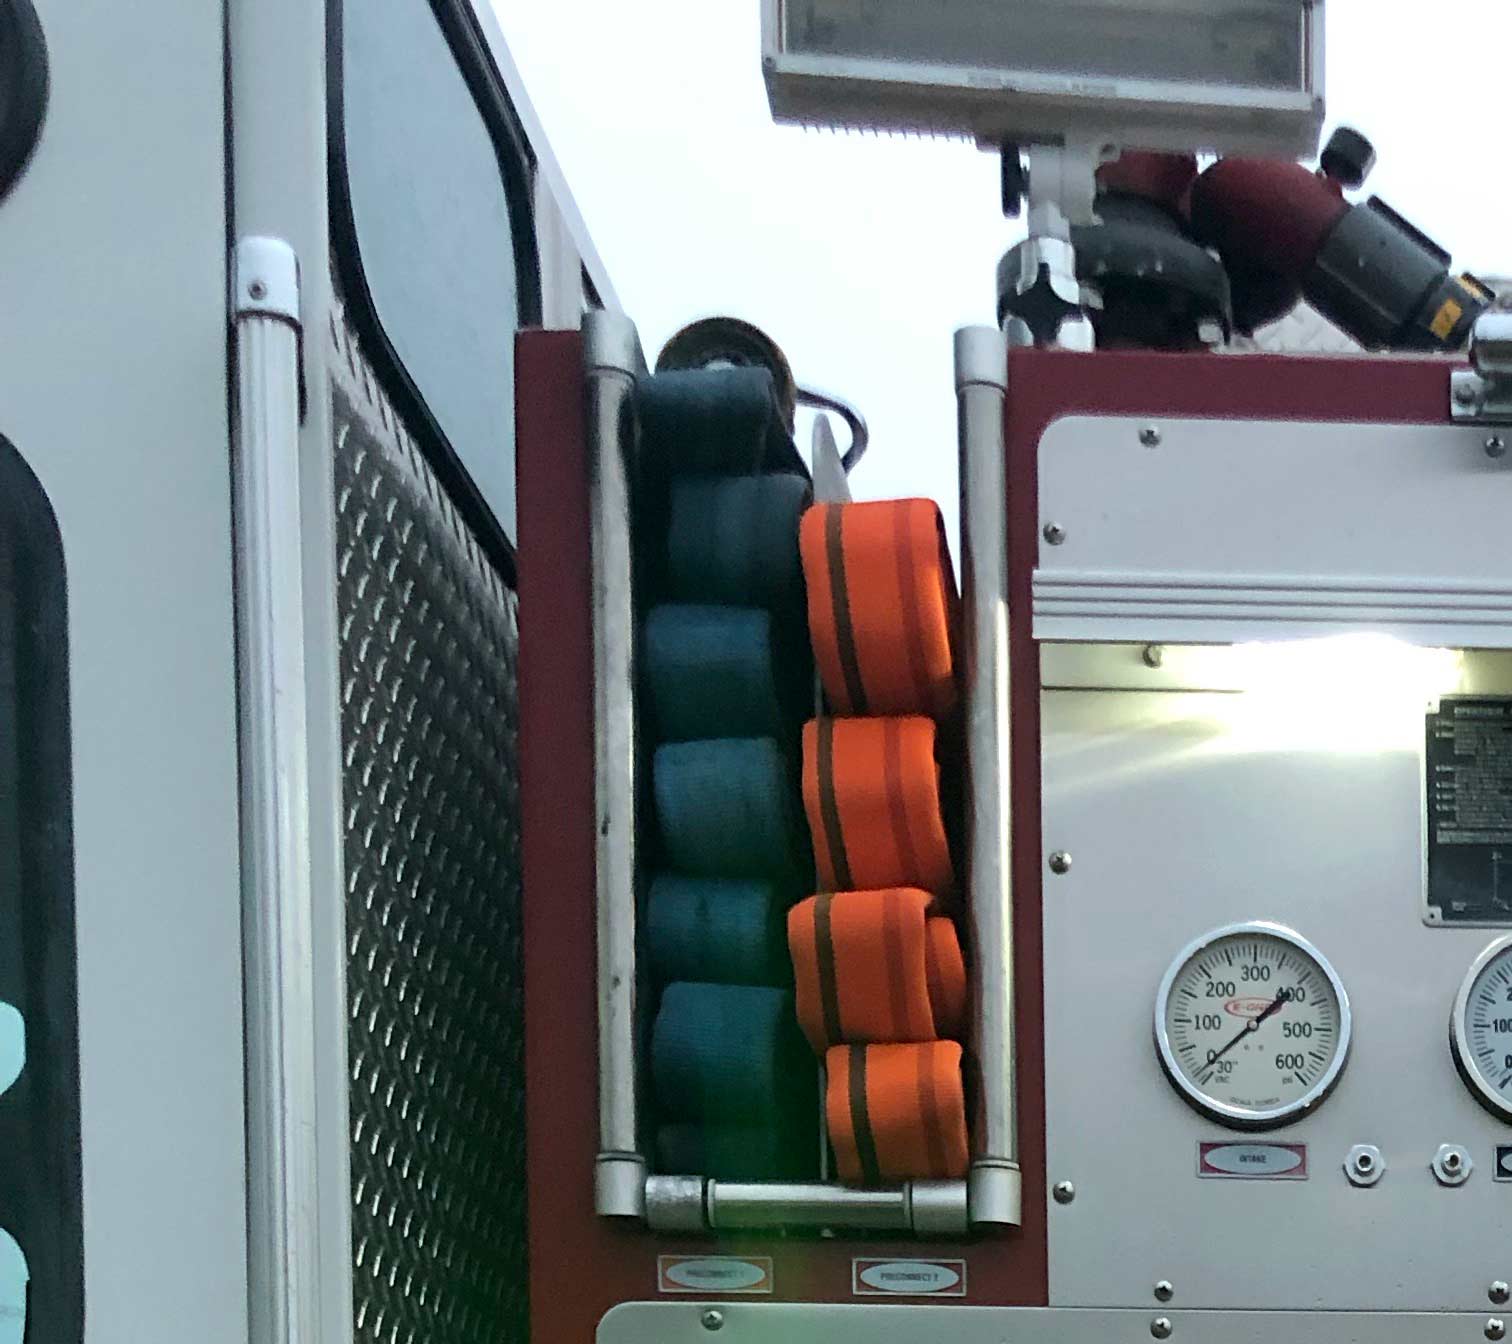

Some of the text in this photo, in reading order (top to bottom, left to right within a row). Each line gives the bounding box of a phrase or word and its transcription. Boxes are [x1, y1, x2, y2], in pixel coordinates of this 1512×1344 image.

[1241, 965, 1270, 981] 300
[1206, 982, 1235, 997] 200
[1195, 1015, 1221, 1030] 100
[1283, 1022, 1311, 1038] 500
[1276, 1054, 1304, 1069] 600
